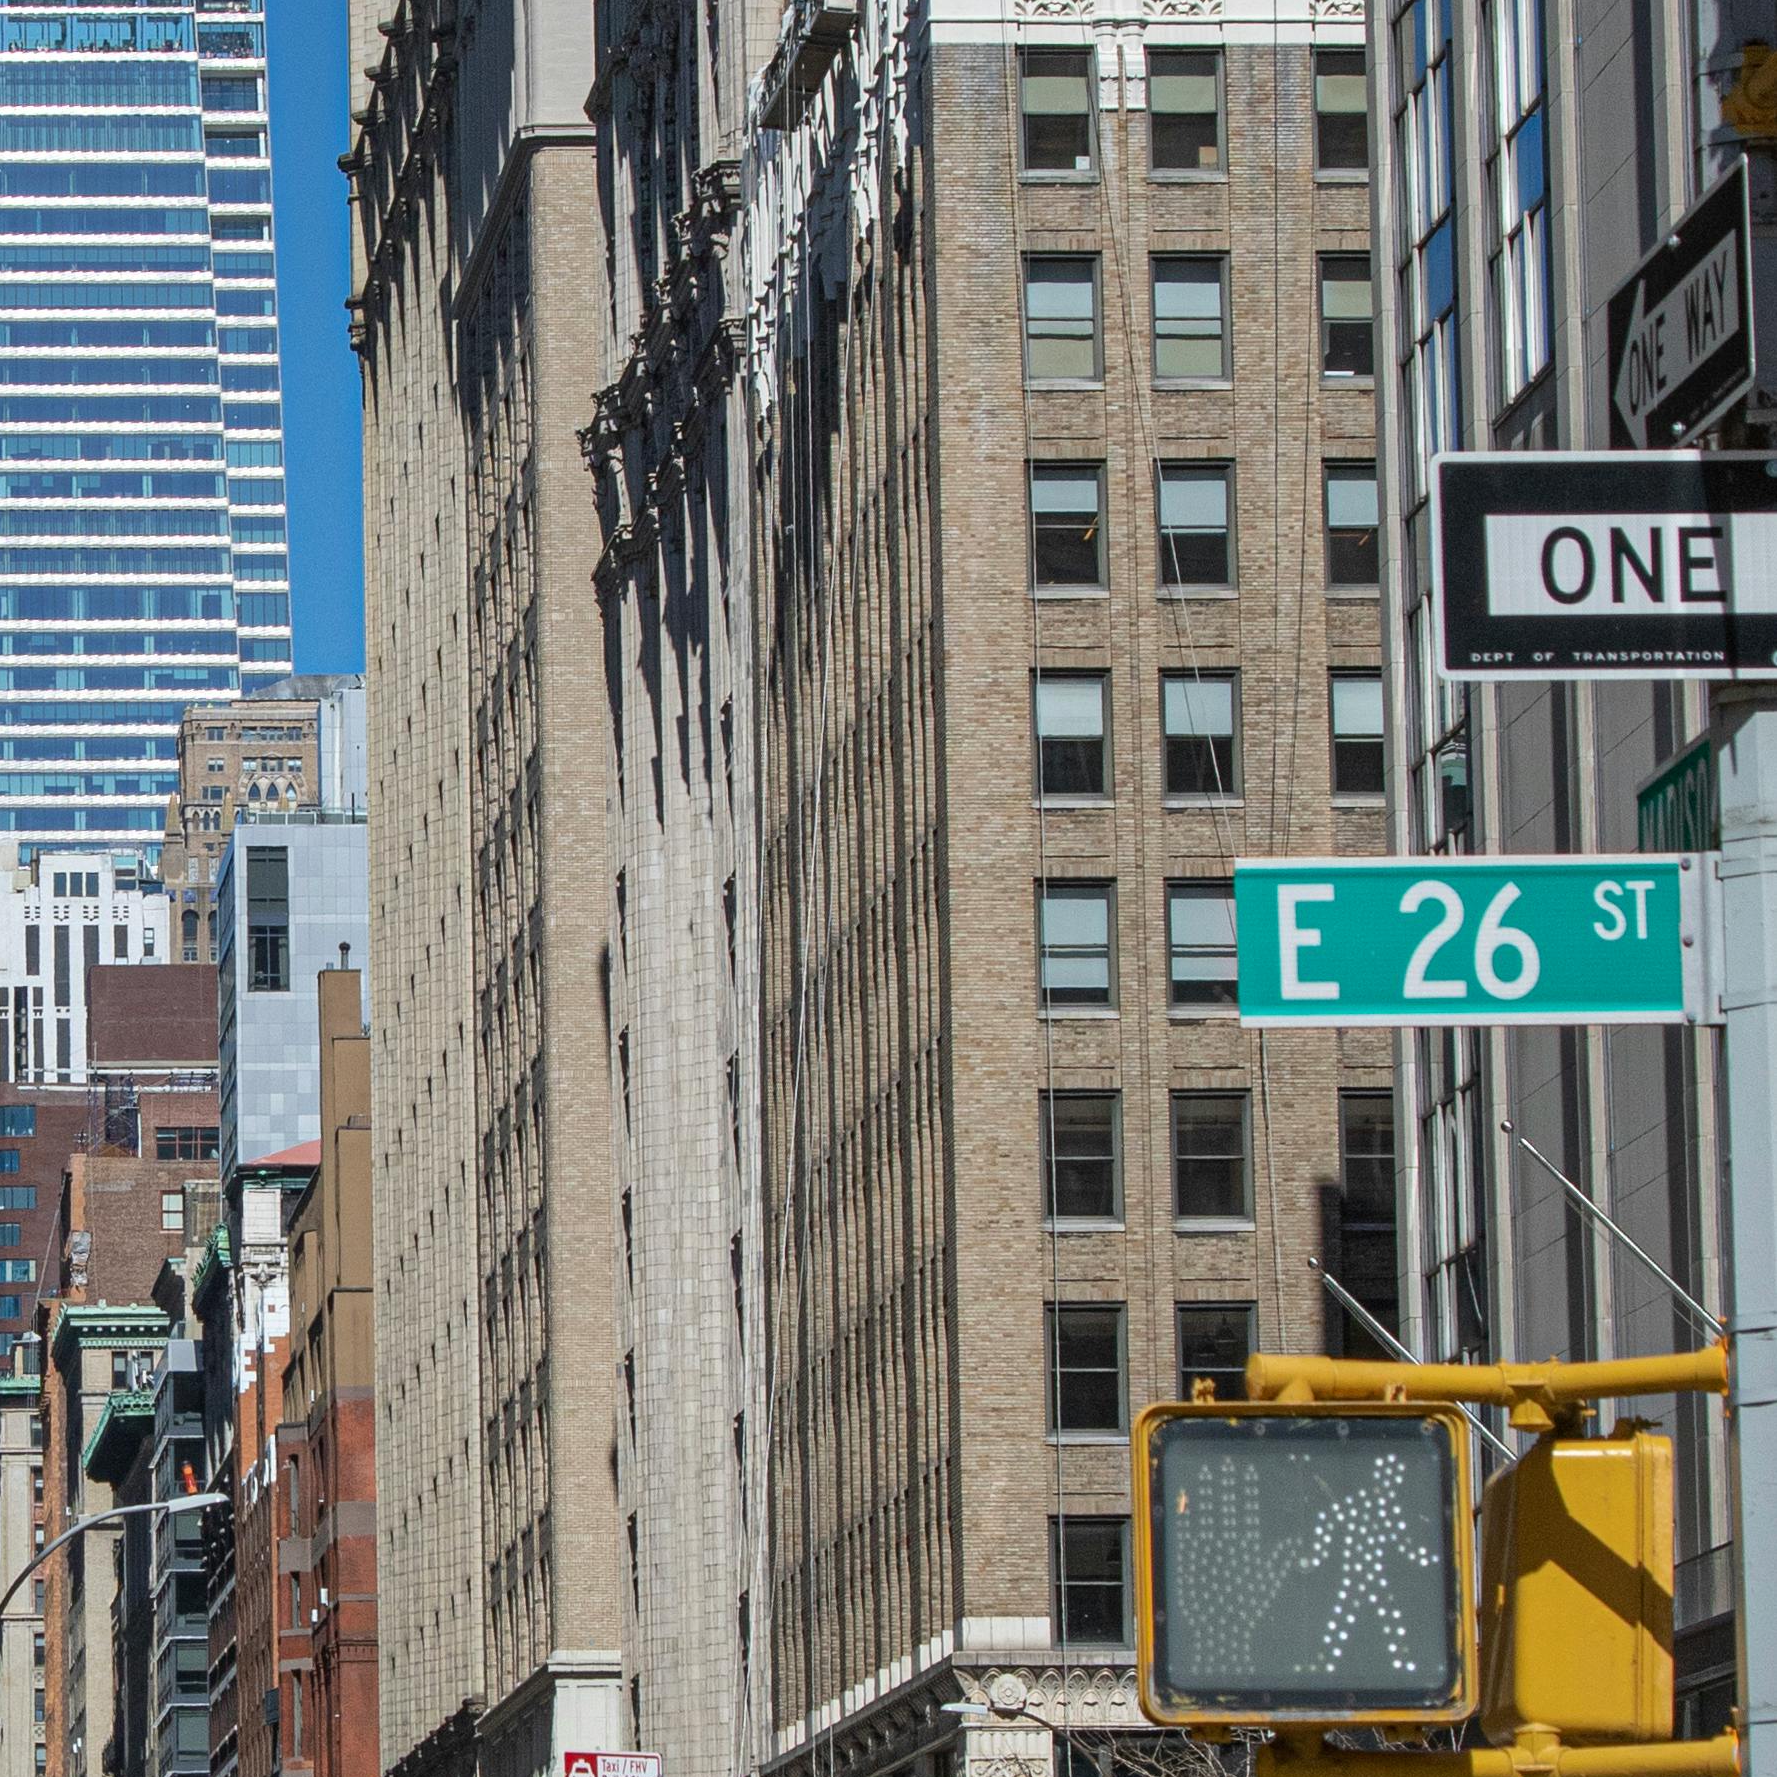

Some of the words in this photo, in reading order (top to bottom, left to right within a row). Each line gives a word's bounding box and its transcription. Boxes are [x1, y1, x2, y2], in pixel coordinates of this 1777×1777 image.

[1629, 311, 1667, 416] ONE
[1684, 250, 1727, 364] WAY
[1541, 526, 1727, 604] ONE
[1472, 651, 1514, 663] DEPT
[1533, 651, 1554, 662] OF
[1573, 651, 1725, 662] TRANSPORTATION
[1277, 883, 1340, 1000] E
[1399, 880, 1541, 1000] 26
[1593, 880, 1655, 941] ST
[601, 1759, 619, 1772] Taxi
[630, 1760, 648, 1773] FHV
